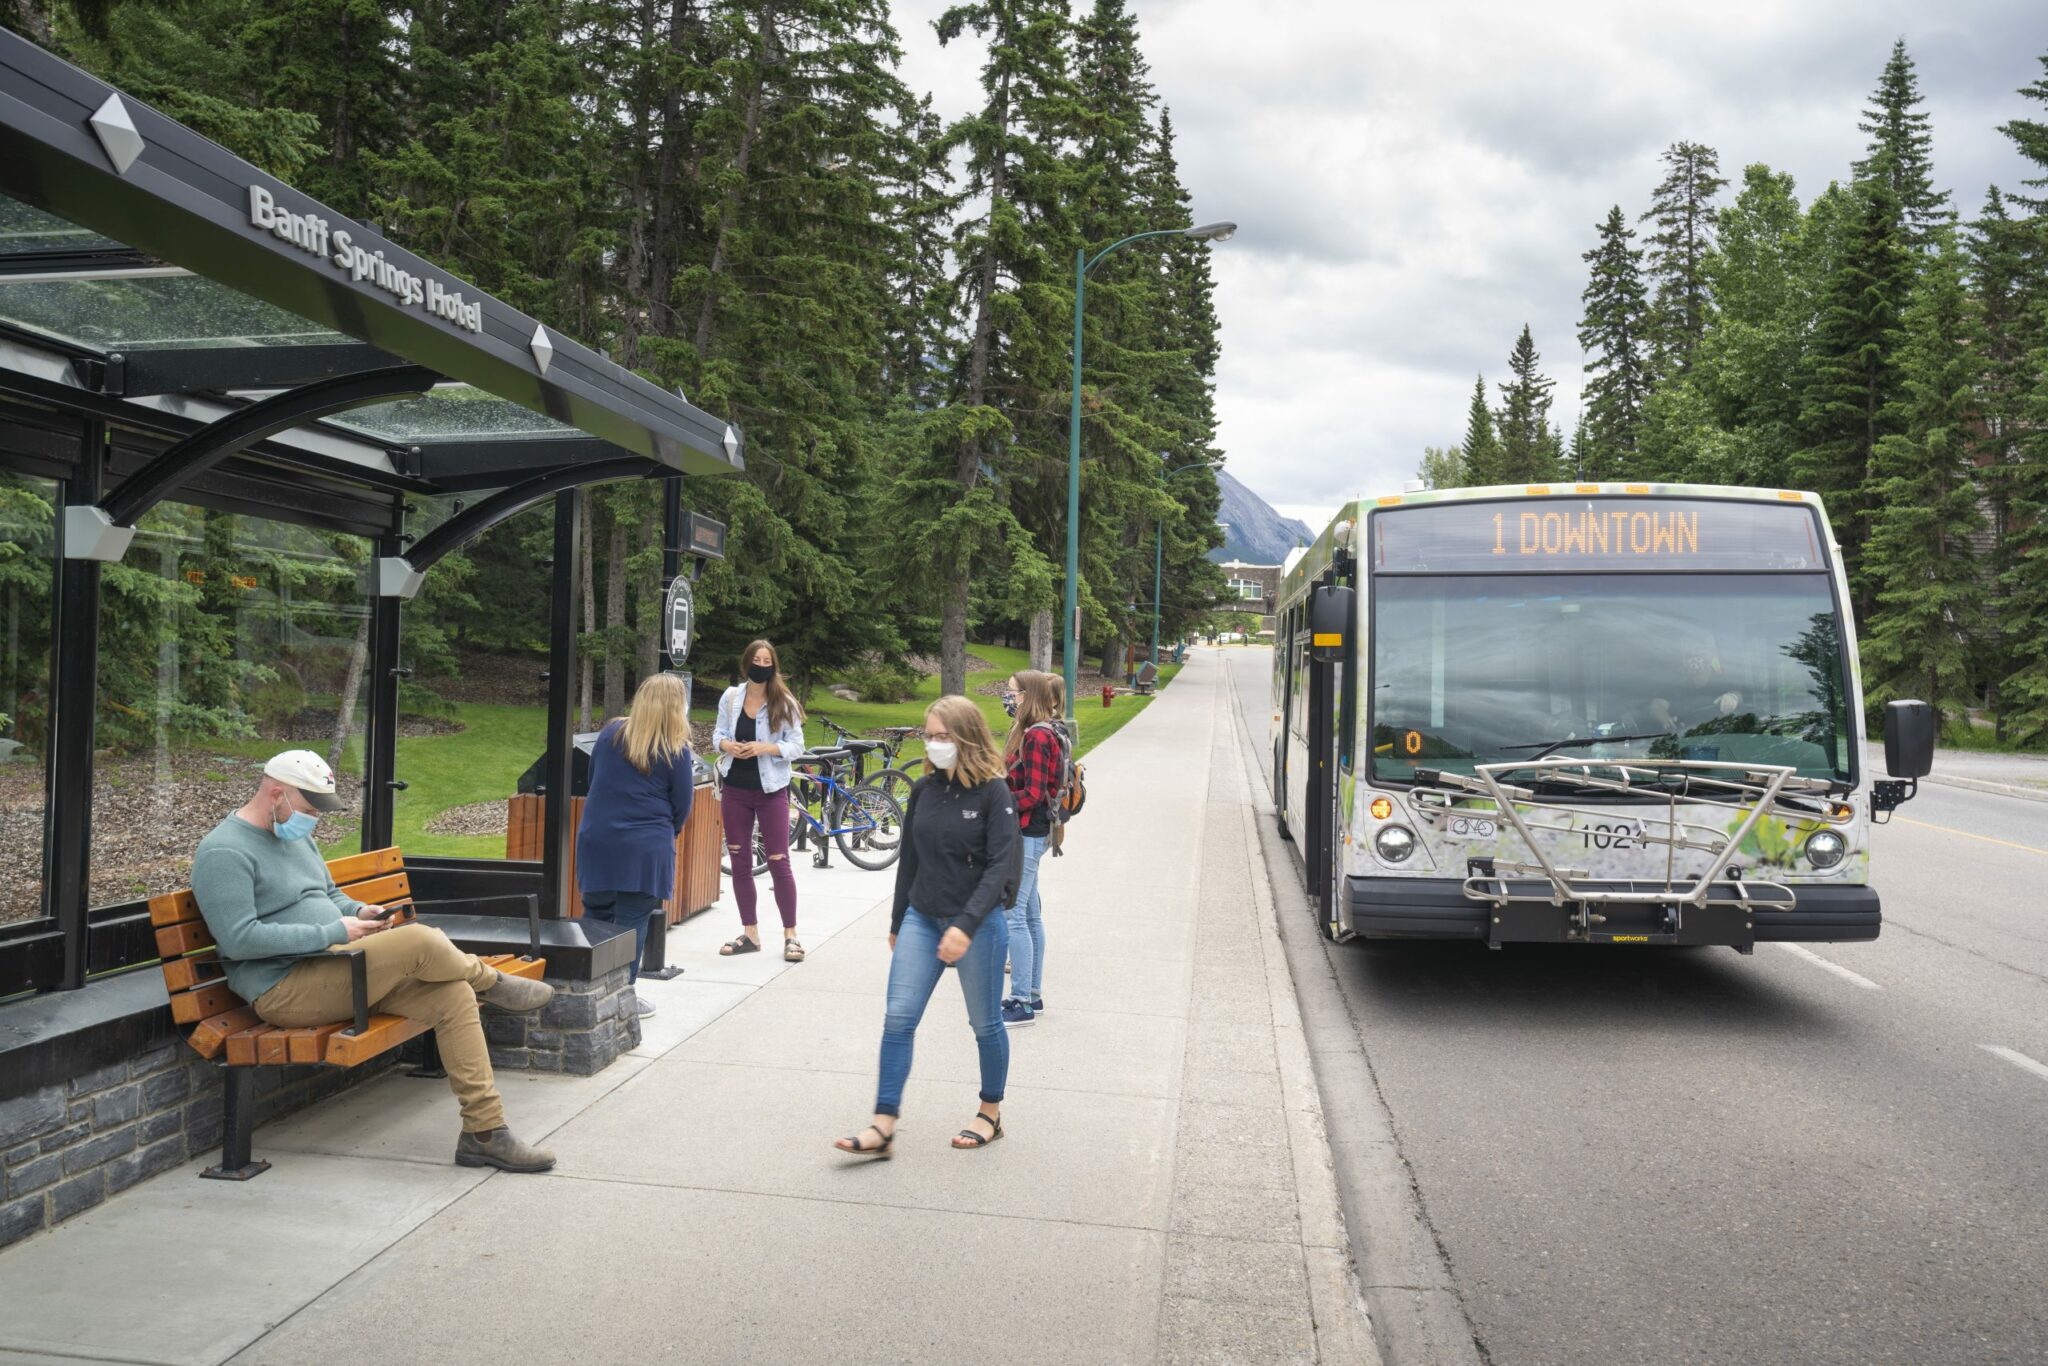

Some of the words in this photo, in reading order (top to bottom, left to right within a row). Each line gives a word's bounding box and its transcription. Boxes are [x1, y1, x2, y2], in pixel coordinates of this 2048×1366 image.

[250, 185, 329, 257] Banff
[333, 230, 424, 305] Springs
[425, 278, 483, 333] Hotel
[1492, 512, 1506, 554] 1
[1520, 511, 1698, 554] DOWNTOWN
